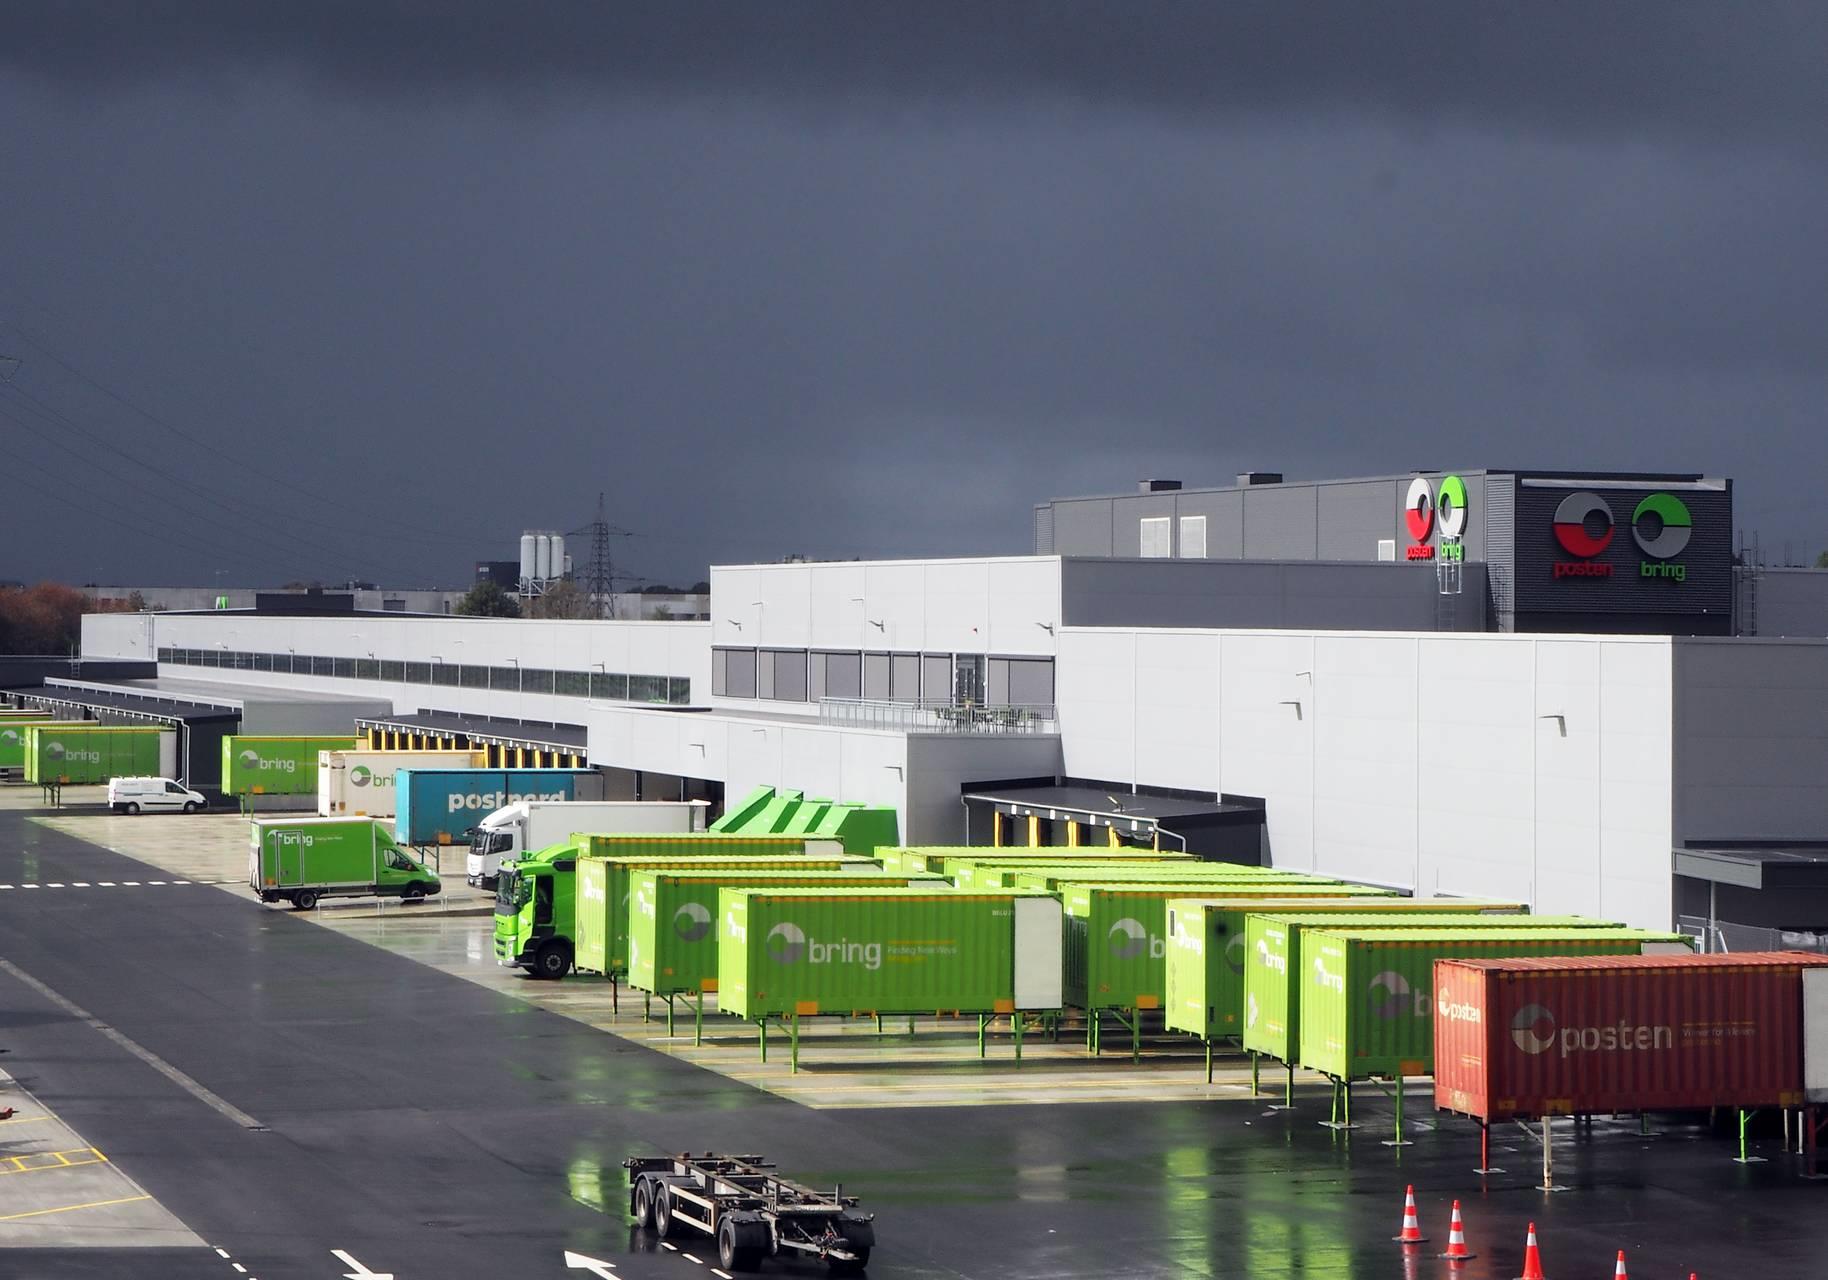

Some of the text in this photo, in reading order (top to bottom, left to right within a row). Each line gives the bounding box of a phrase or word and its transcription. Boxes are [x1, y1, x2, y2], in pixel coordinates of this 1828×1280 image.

[1554, 560, 1615, 578] posten
[1641, 561, 1686, 581] bring
[66, 749, 99, 763] bring
[260, 757, 295, 773] bring
[373, 774, 397, 787] bri
[283, 833, 313, 847] bring
[808, 937, 881, 970] bring
[1450, 1002, 1481, 1023] posten
[1561, 1018, 1673, 1058] posten
